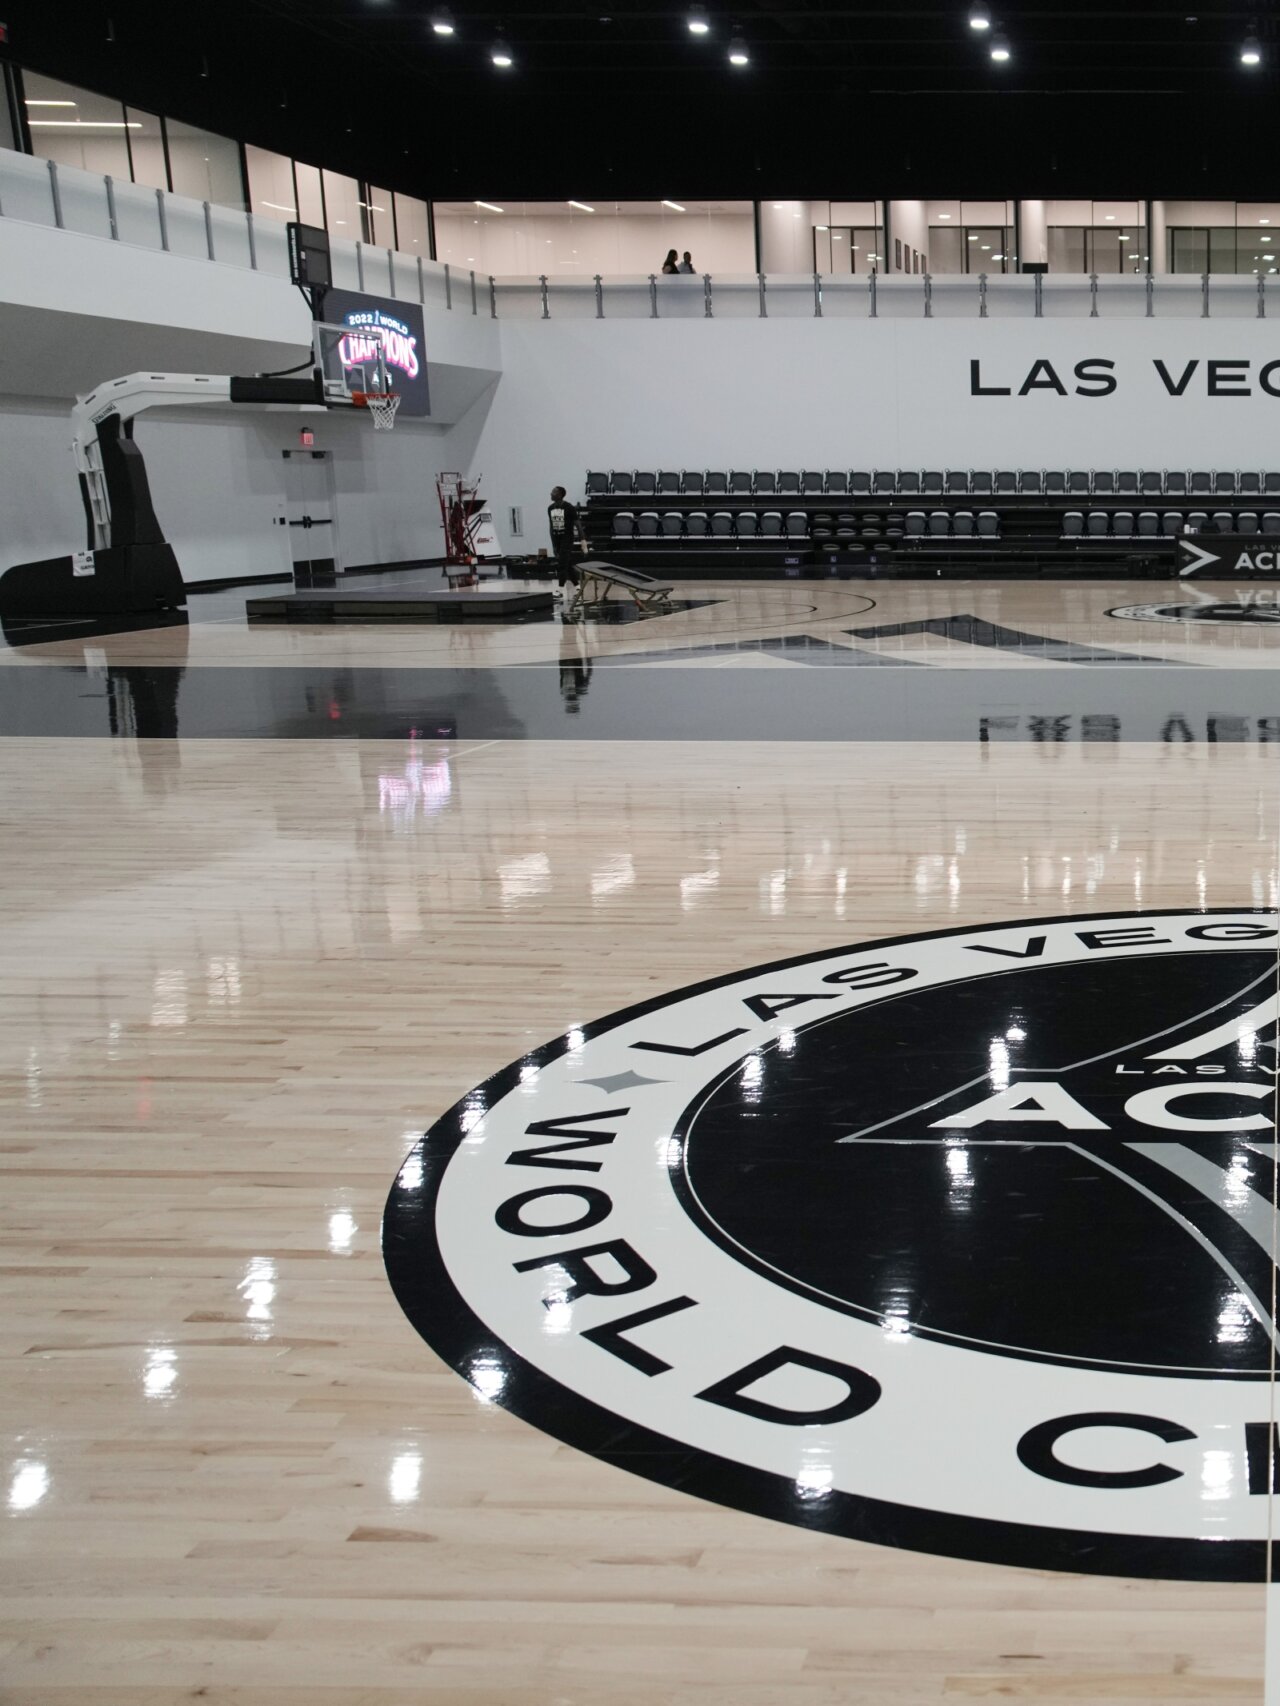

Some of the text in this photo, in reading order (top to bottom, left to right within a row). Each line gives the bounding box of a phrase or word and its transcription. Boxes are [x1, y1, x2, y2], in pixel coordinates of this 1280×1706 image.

[348, 313, 409, 335] 2022 WORLD
[970, 358, 1118, 398] LAS
[628, 961, 921, 1058] LAS
[1115, 1064, 1228, 1076] LAS
[493, 1105, 883, 1428] WORLD
